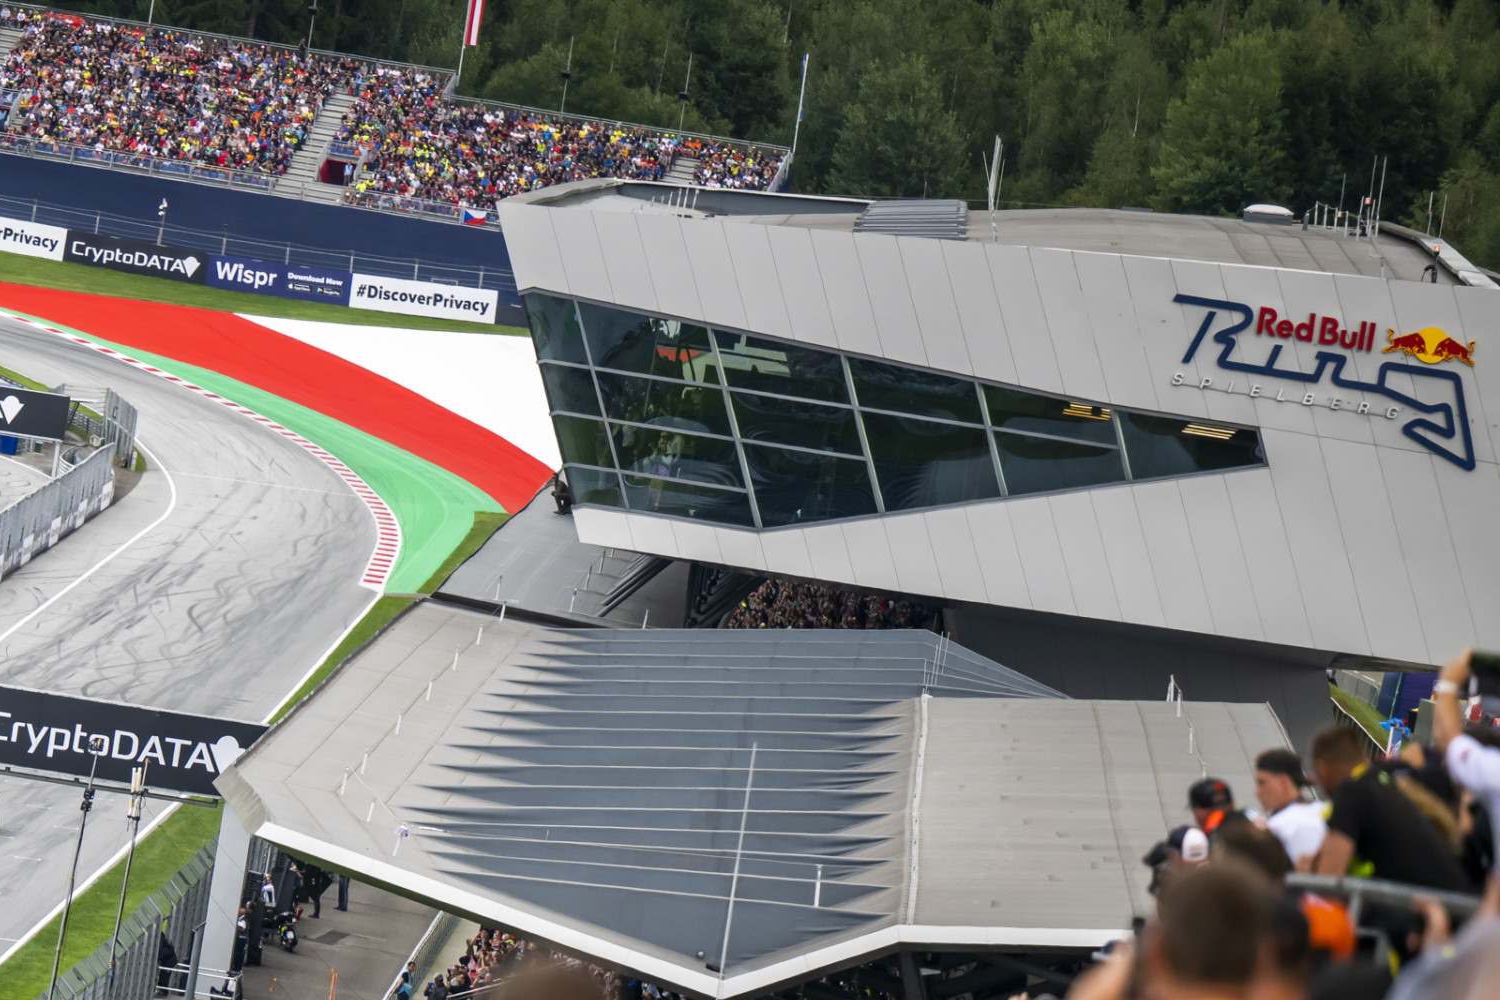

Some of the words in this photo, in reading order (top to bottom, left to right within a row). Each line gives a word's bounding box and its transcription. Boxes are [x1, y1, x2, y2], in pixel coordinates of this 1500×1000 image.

[72, 241, 186, 273] CryptoDATA
[216, 261, 277, 289] Wispr
[356, 284, 489, 315] #DiscoverPrivacy
[1257, 306, 1316, 342] Red
[1318, 316, 1376, 352] Bull
[1171, 372, 1399, 419] SPIELBERG
